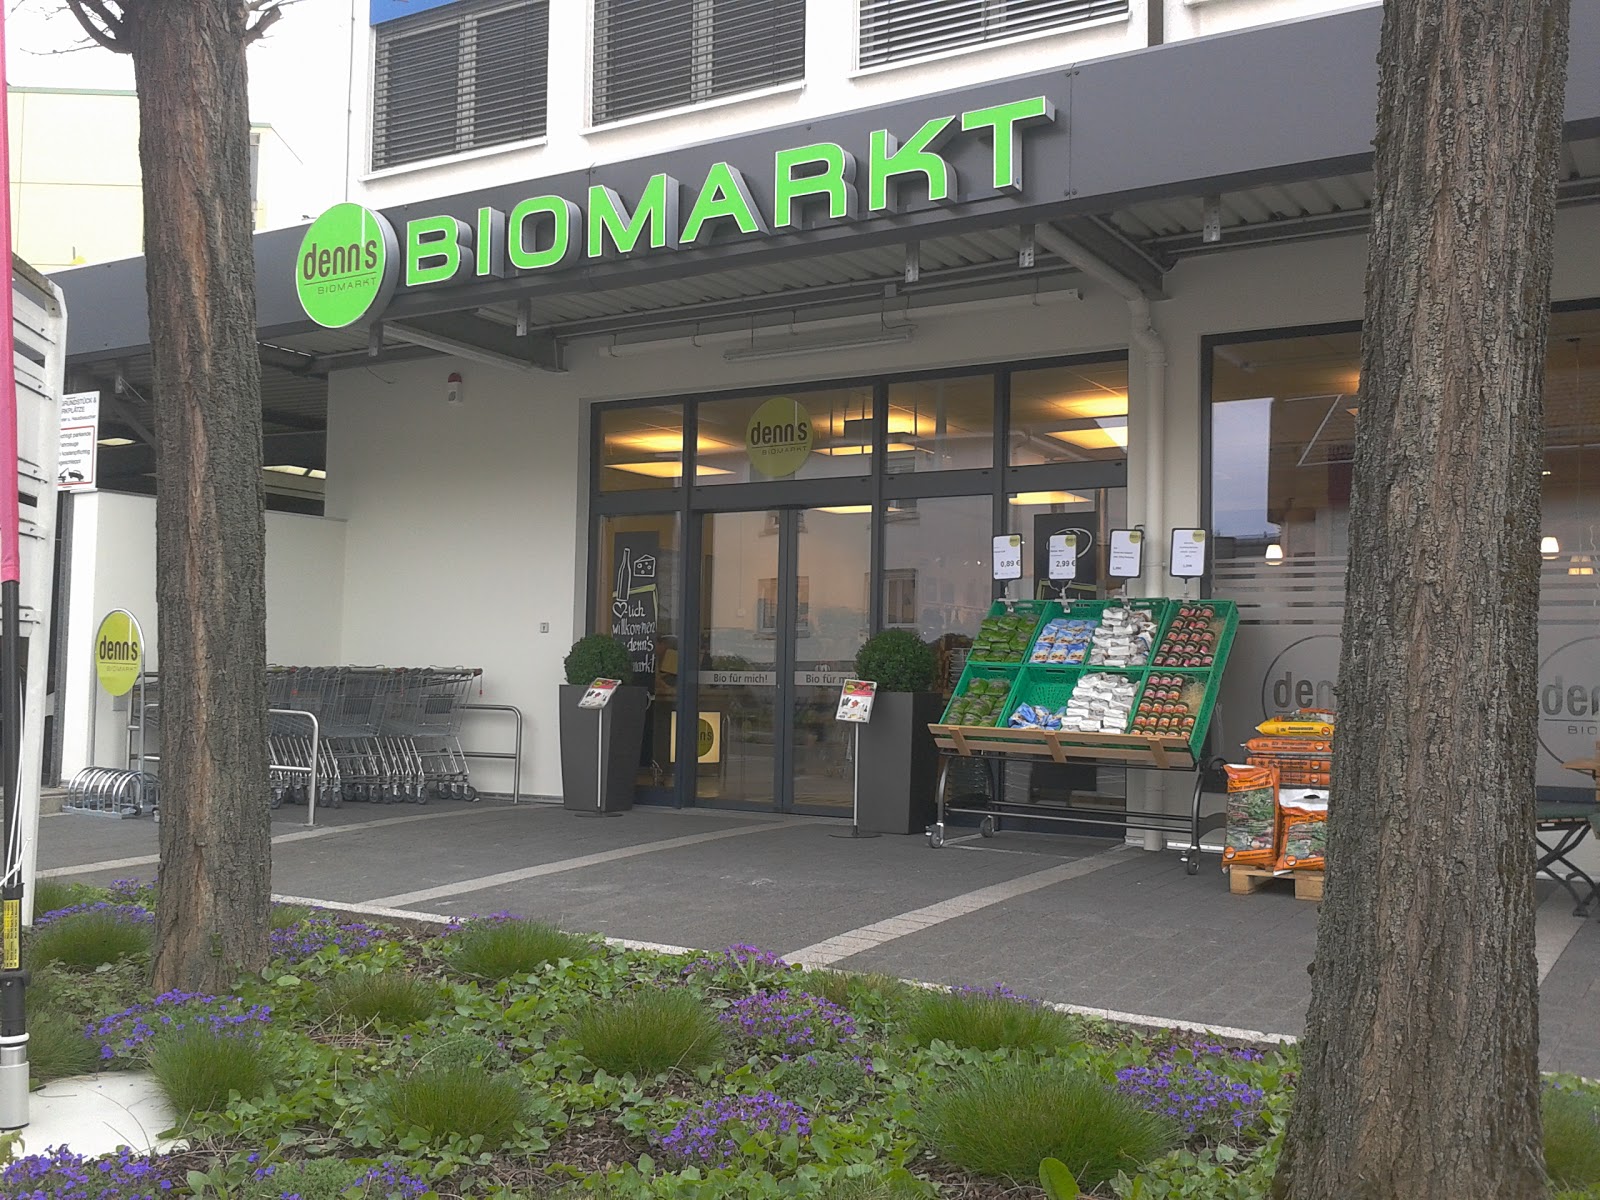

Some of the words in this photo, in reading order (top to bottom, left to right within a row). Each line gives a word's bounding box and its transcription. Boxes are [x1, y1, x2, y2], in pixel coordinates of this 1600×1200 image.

[405, 96, 1047, 287] BIOMARKT
[317, 277, 377, 294] BIOMARKT
[762, 446, 807, 455] BIOMARKT
[1000, 560, 1014, 568] 0,89
[1056, 560, 1070, 568] 2,99
[612, 618, 656, 636] willkommen
[627, 636, 654, 652] denn's
[713, 673, 726, 683] Bio
[729, 673, 741, 683] für
[744, 674, 768, 683] mich!
[805, 674, 819, 683] Bio
[822, 674, 835, 683] für
